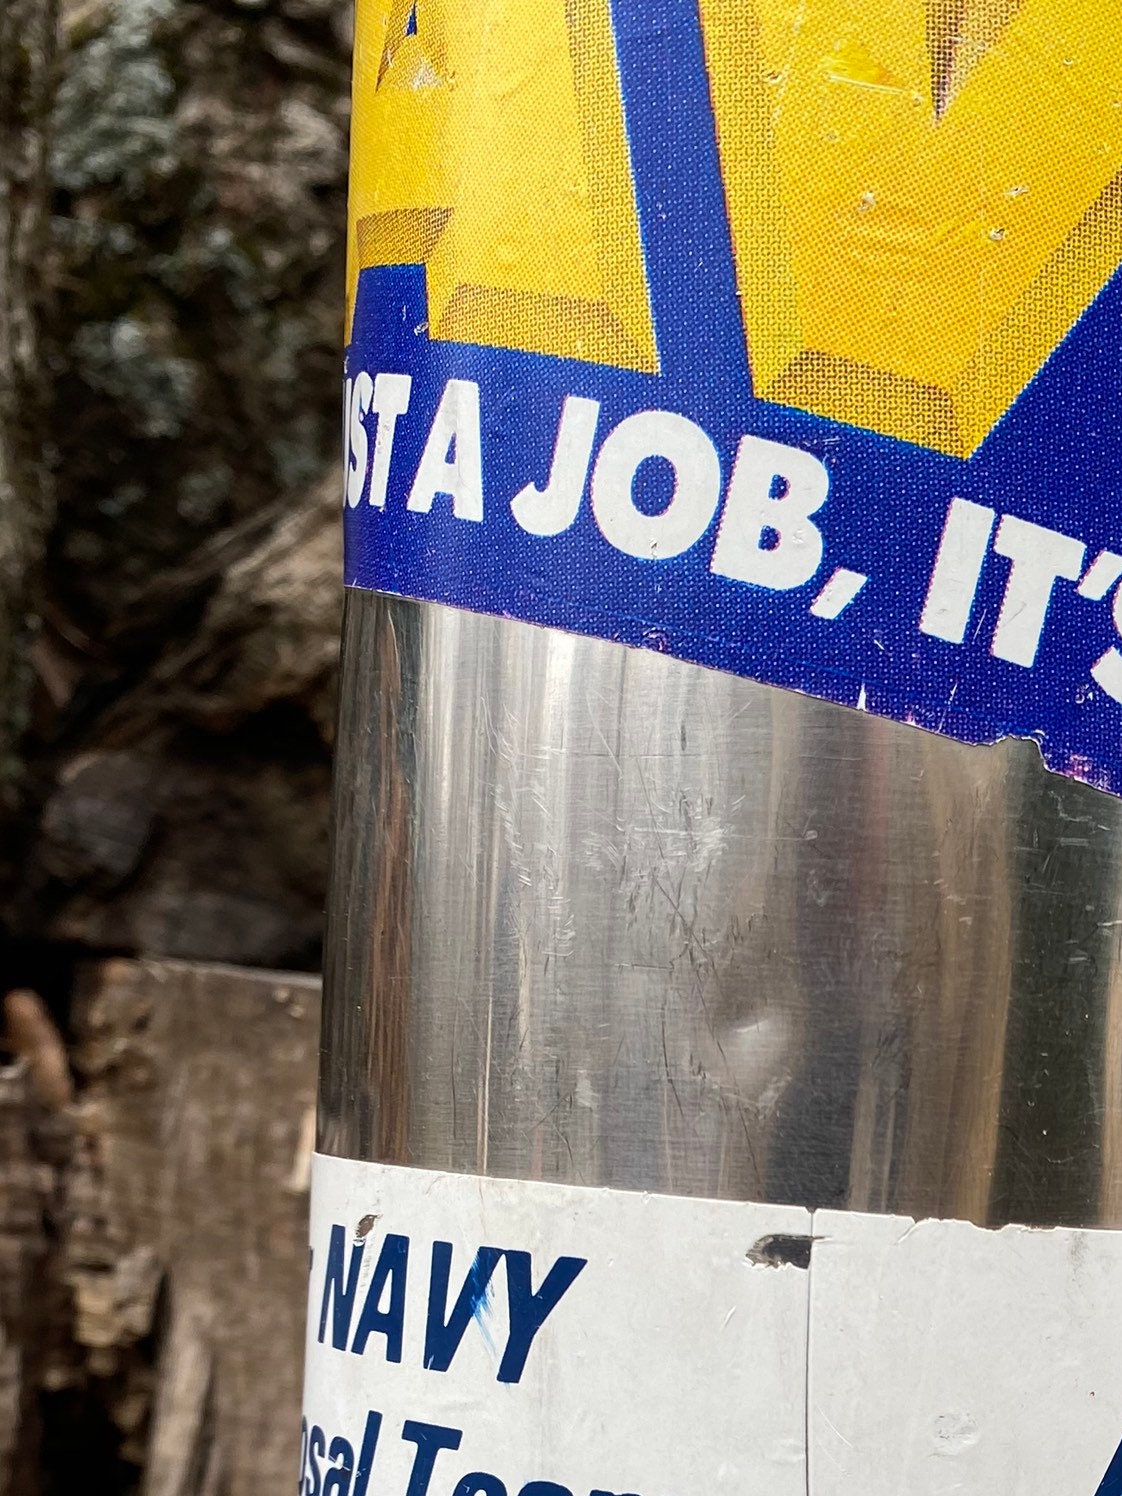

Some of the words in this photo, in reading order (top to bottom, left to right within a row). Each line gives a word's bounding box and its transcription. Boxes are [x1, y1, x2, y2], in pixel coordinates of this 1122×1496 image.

[407, 379, 483, 523] A
[511, 395, 868, 620] JOB,
[318, 1224, 588, 1384] NAVY
